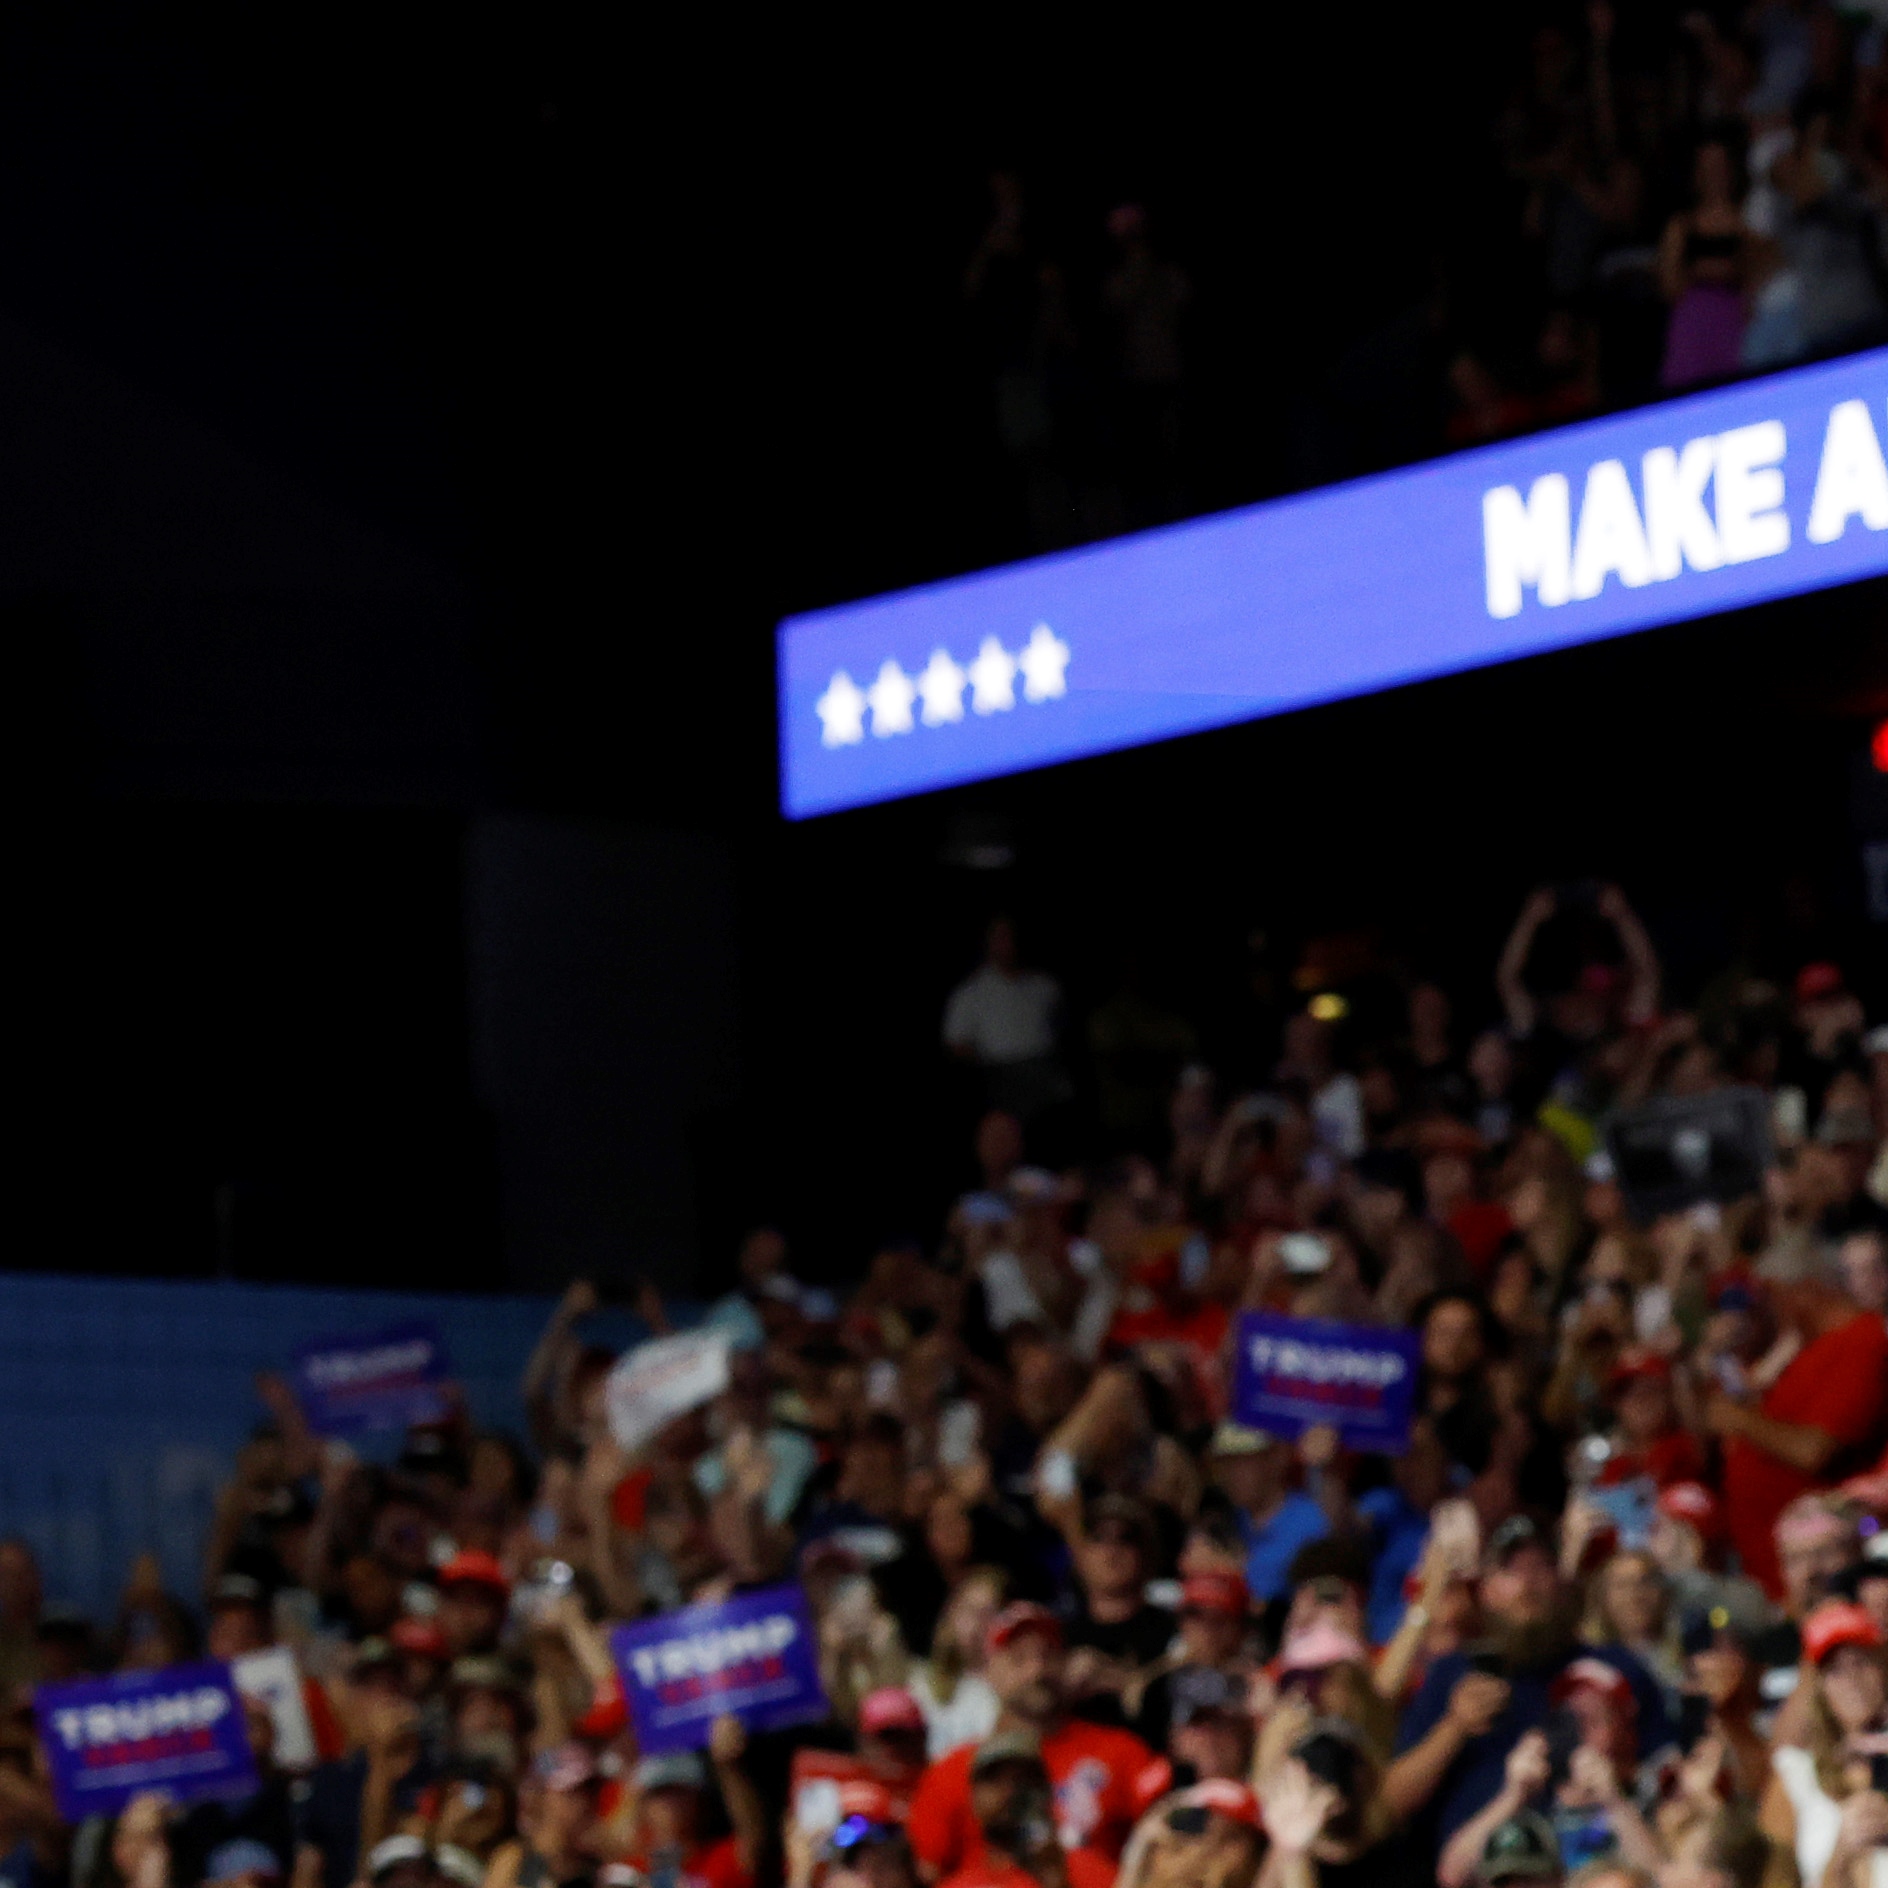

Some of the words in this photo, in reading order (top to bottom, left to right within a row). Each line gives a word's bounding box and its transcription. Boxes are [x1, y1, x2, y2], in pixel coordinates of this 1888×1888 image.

[1482, 420, 1791, 619] MAKE
[632, 1614, 797, 1688] TRUMP
[54, 1687, 230, 1750] TRUMP
